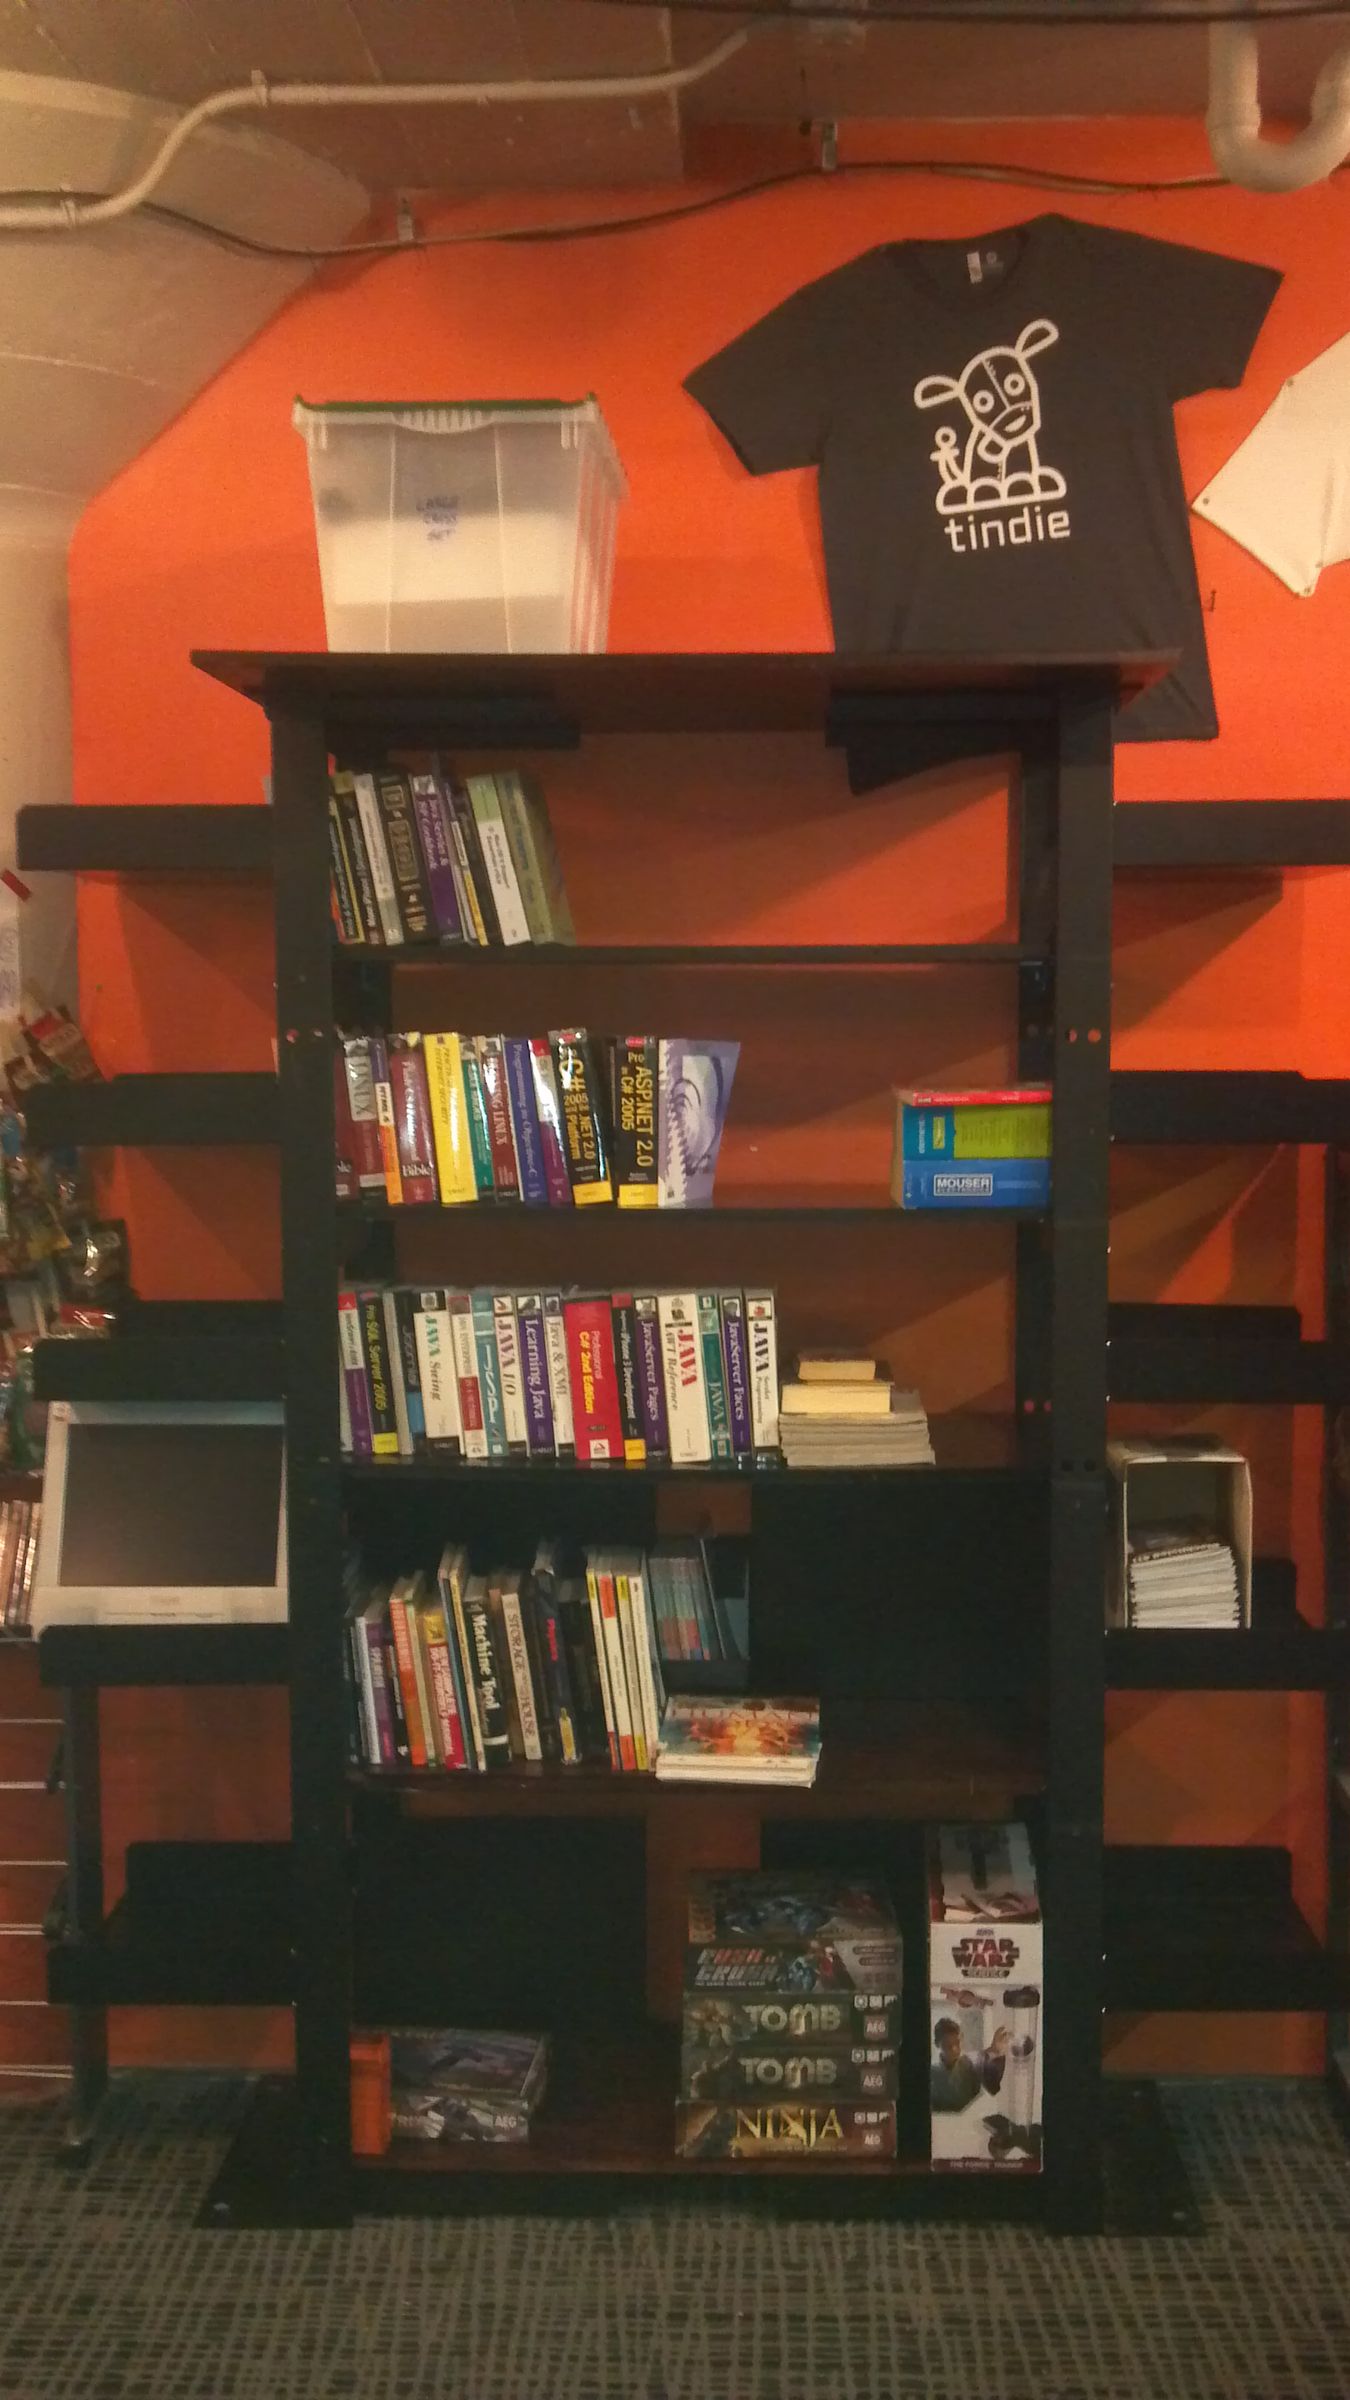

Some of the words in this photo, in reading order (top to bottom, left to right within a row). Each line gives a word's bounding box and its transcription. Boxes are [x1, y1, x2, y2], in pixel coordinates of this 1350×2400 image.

[944, 506, 1071, 553] tindie
[628, 1051, 645, 1063] Pro
[513, 1043, 526, 1106] Programming
[622, 1076, 633, 1094] C#
[564, 1095, 588, 1104] 2005
[621, 1097, 635, 1131] 2005
[635, 1066, 654, 1135] ASP.NET
[493, 1111, 506, 1145] LINUX
[567, 1115, 581, 1159] Platform
[583, 1140, 595, 1159] 2.0
[636, 1140, 654, 1166] 2.0
[402, 1164, 430, 1177] Bible
[936, 1177, 991, 1188] MOUSER
[366, 1321, 379, 1341] SQL
[425, 1314, 440, 1356] JAVA
[498, 1320, 515, 1367] JAVA
[547, 1321, 560, 1346] Java
[579, 1331, 589, 1348] C#
[620, 1333, 631, 1358] iPhone
[665, 1331, 675, 1354] AWT
[753, 1323, 769, 1372] JAVA
[369, 1346, 382, 1379] Server
[525, 1319, 542, 1386] Learning
[553, 1351, 564, 1361] &
[580, 1352, 592, 1373] 2nd
[591, 1331, 602, 1378] Professional
[641, 1321, 656, 1383] JavaServer
[678, 1329, 697, 1386] JAVA
[728, 1321, 742, 1384] JavaServer
[373, 1383, 387, 1410] 2005
[429, 1360, 444, 1401] Swing
[504, 1373, 516, 1395] I/O
[554, 1367, 567, 1398] XML
[582, 1375, 595, 1413] Edition
[623, 1367, 636, 1418] Development
[667, 1358, 679, 1410] Reference
[530, 1387, 546, 1419] Java
[647, 1387, 660, 1420] Pages
[709, 1382, 724, 1420] JAVA
[734, 1387, 744, 1420] Faces
[755, 1376, 764, 1424] Programming
[472, 1612, 492, 1675] Machine
[482, 1676, 499, 1710] Tool
[507, 1612, 524, 1673] STORAGE
[520, 1695, 535, 1737] HOUSE
[952, 1947, 1019, 1968] WARS
[960, 1938, 1014, 1953] STAR
[741, 2002, 841, 2037] TOMB
[866, 2020, 887, 2034] AEG
[737, 2056, 838, 2090] TOMB
[863, 2075, 884, 2088] AEG
[495, 2115, 517, 2129] AEG
[735, 2108, 845, 2148] NINJA
[864, 2134, 882, 2146] AEG
